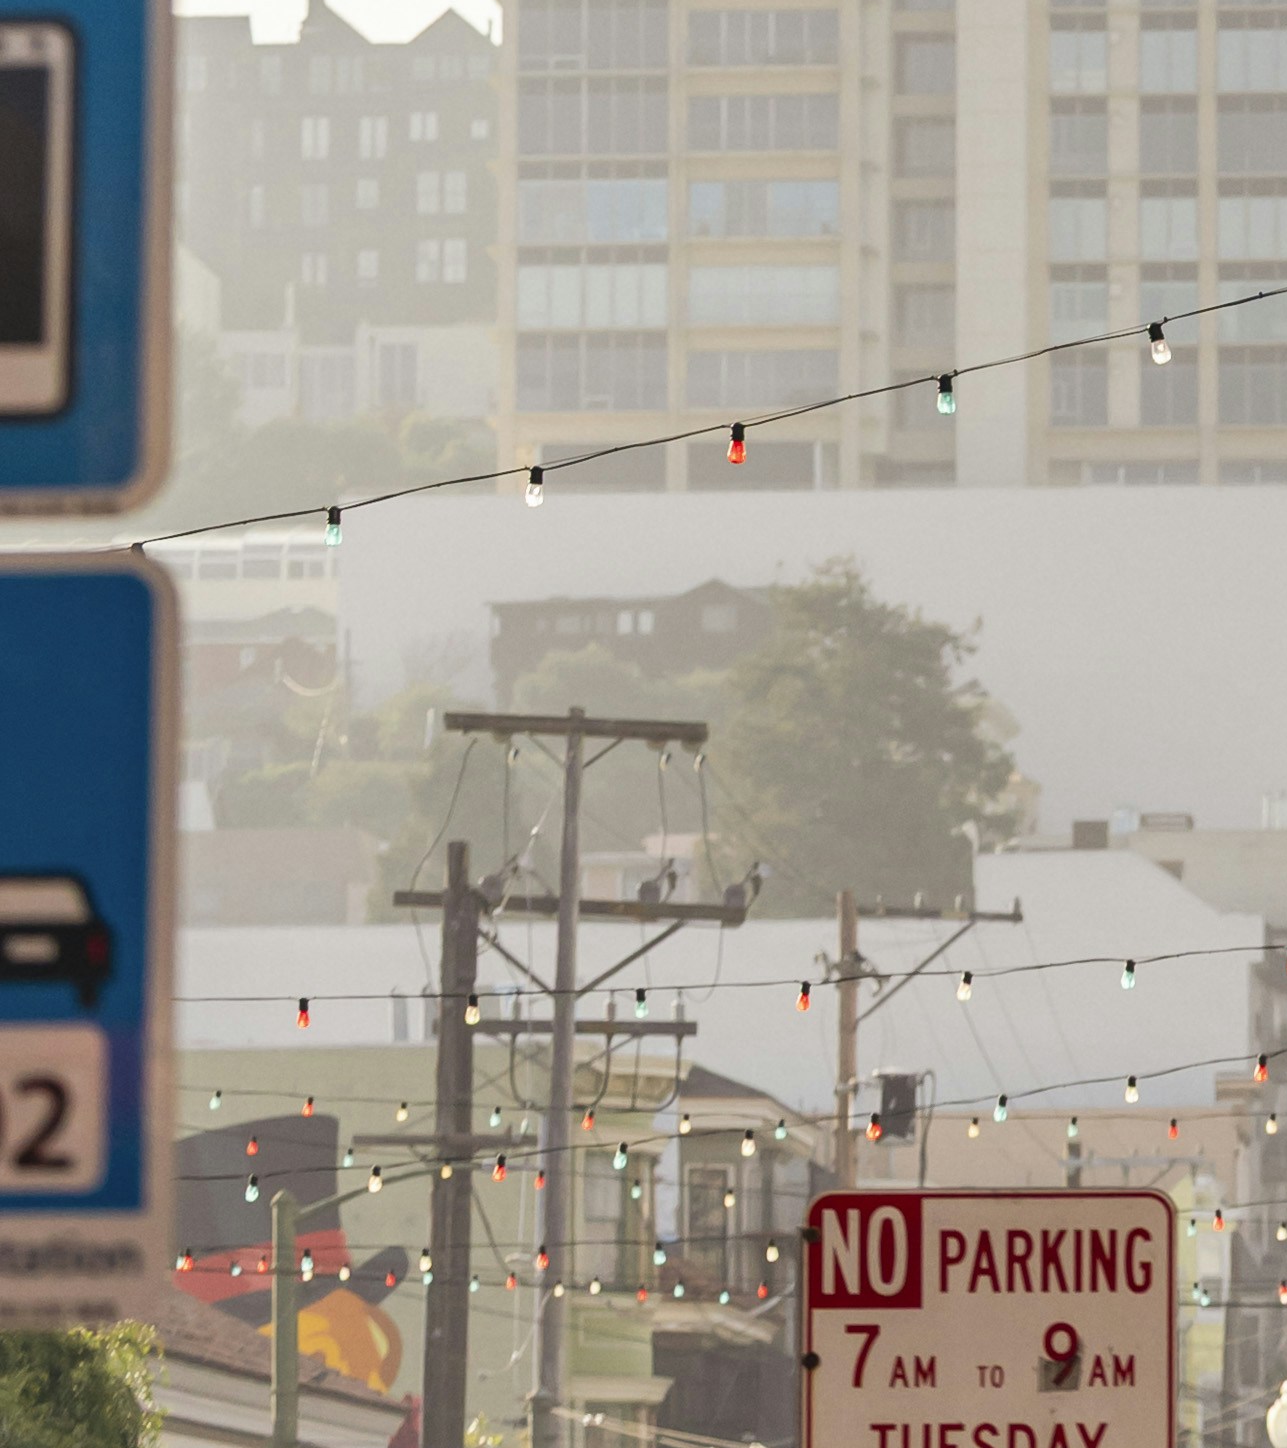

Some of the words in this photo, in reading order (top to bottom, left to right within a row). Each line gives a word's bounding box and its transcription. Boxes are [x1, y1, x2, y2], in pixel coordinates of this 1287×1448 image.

[820, 1204, 910, 1297] NO
[938, 1226, 1154, 1294] PARKING
[845, 1323, 881, 1389] 7
[888, 1355, 937, 1388] AM
[976, 1364, 1005, 1389] TO
[1088, 1354, 1137, 1388] AM
